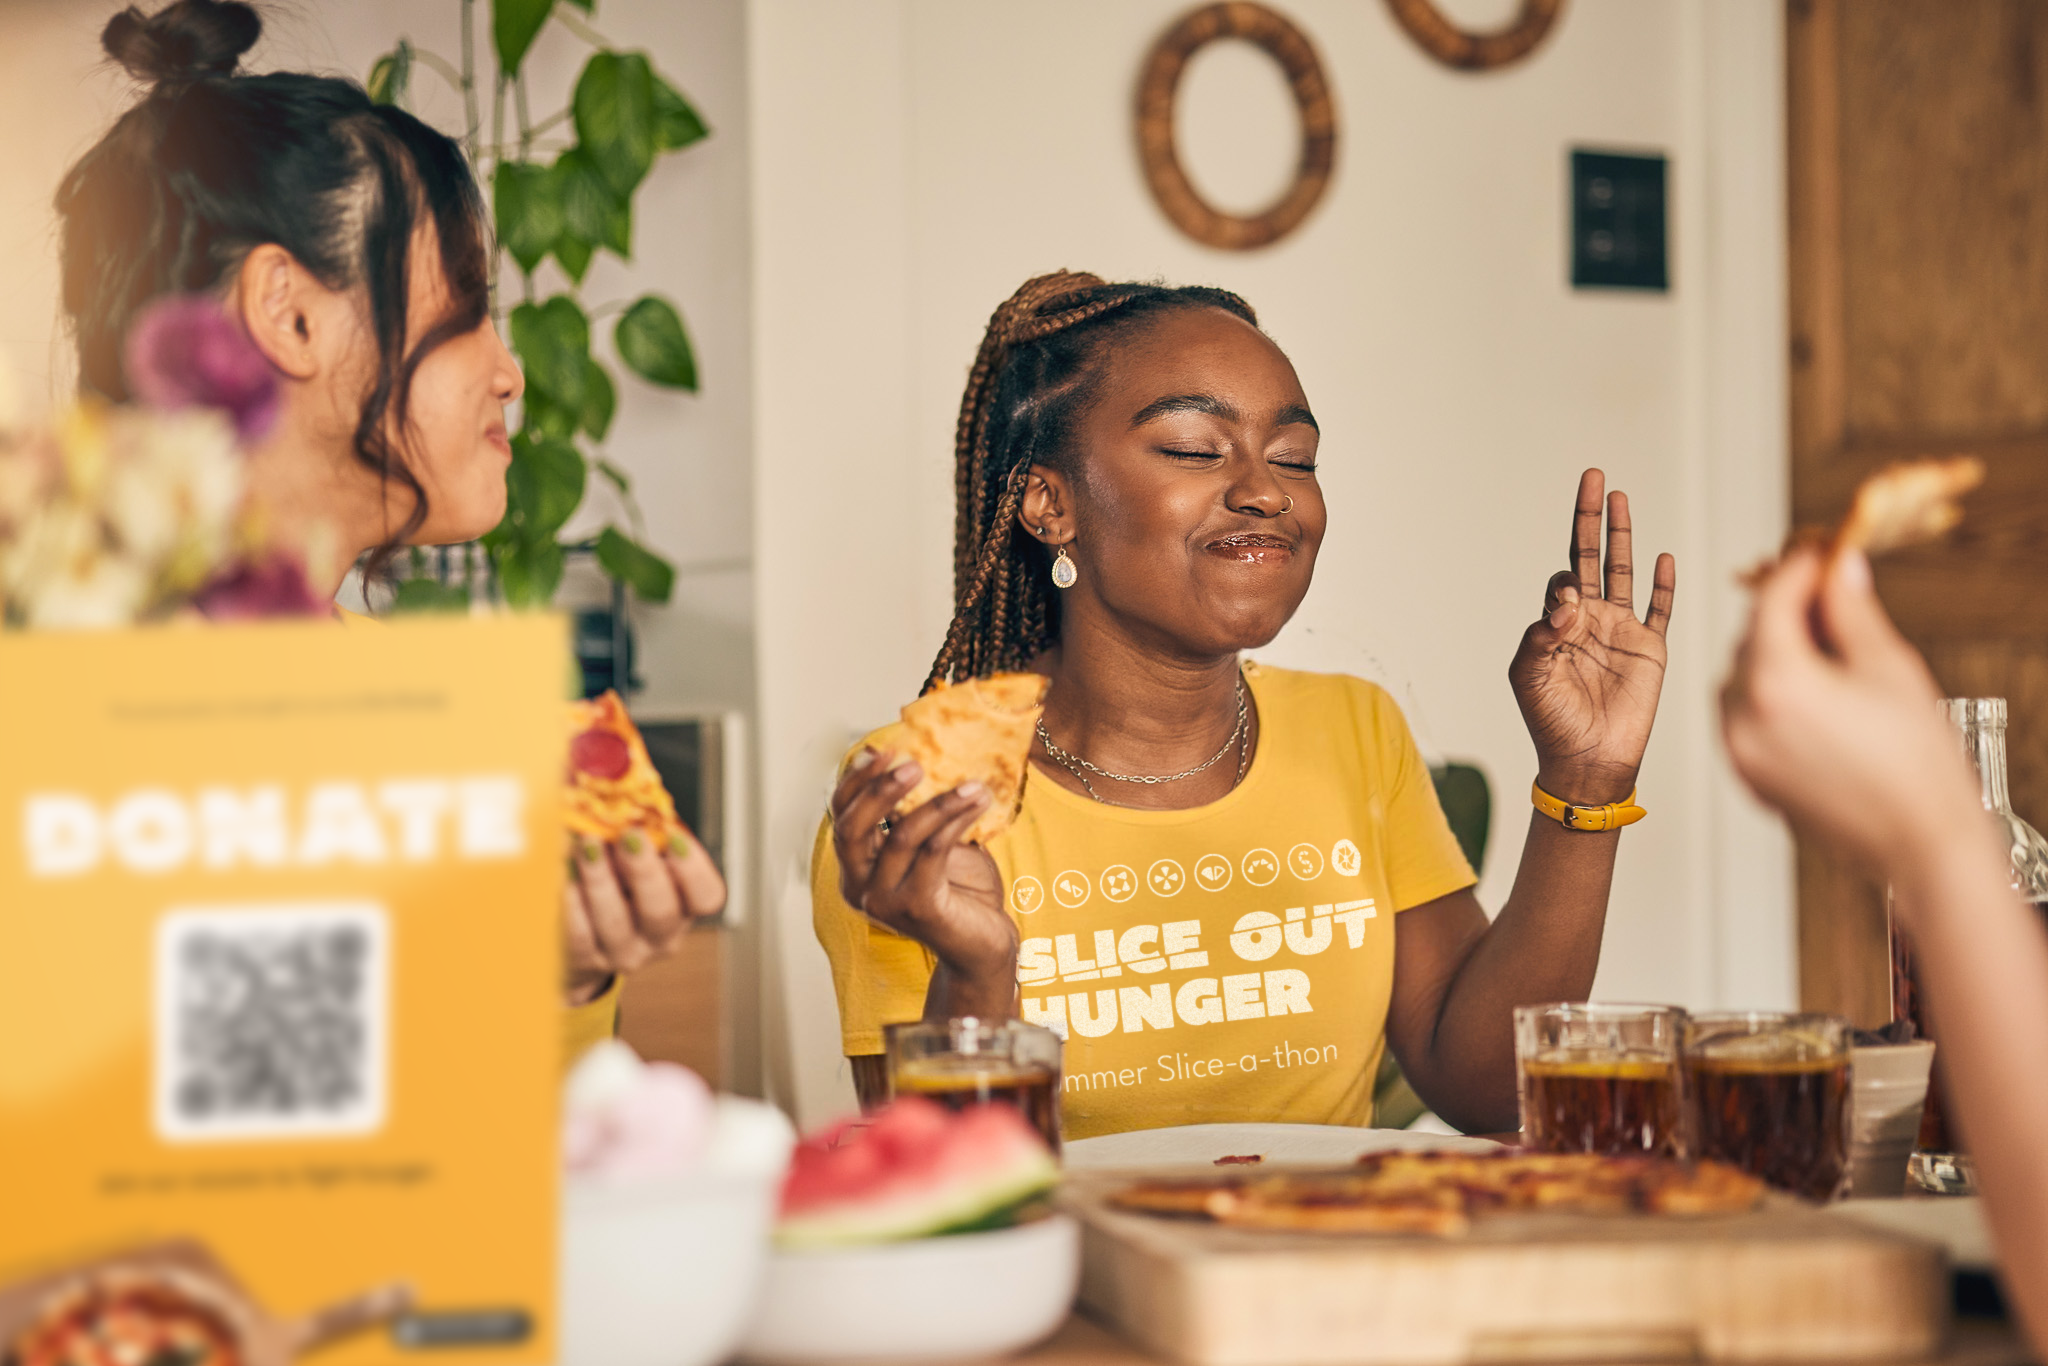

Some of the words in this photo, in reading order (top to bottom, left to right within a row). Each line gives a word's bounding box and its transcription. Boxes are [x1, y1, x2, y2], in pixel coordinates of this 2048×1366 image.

[25, 776, 525, 876] DONATE
[1018, 919, 1209, 986] SLICE
[1230, 898, 1377, 961] OUT
[1022, 968, 1313, 1041] HUNGER
[1060, 1067, 1147, 1092] mmer
[1157, 1040, 1338, 1082] Slice-a-thon
